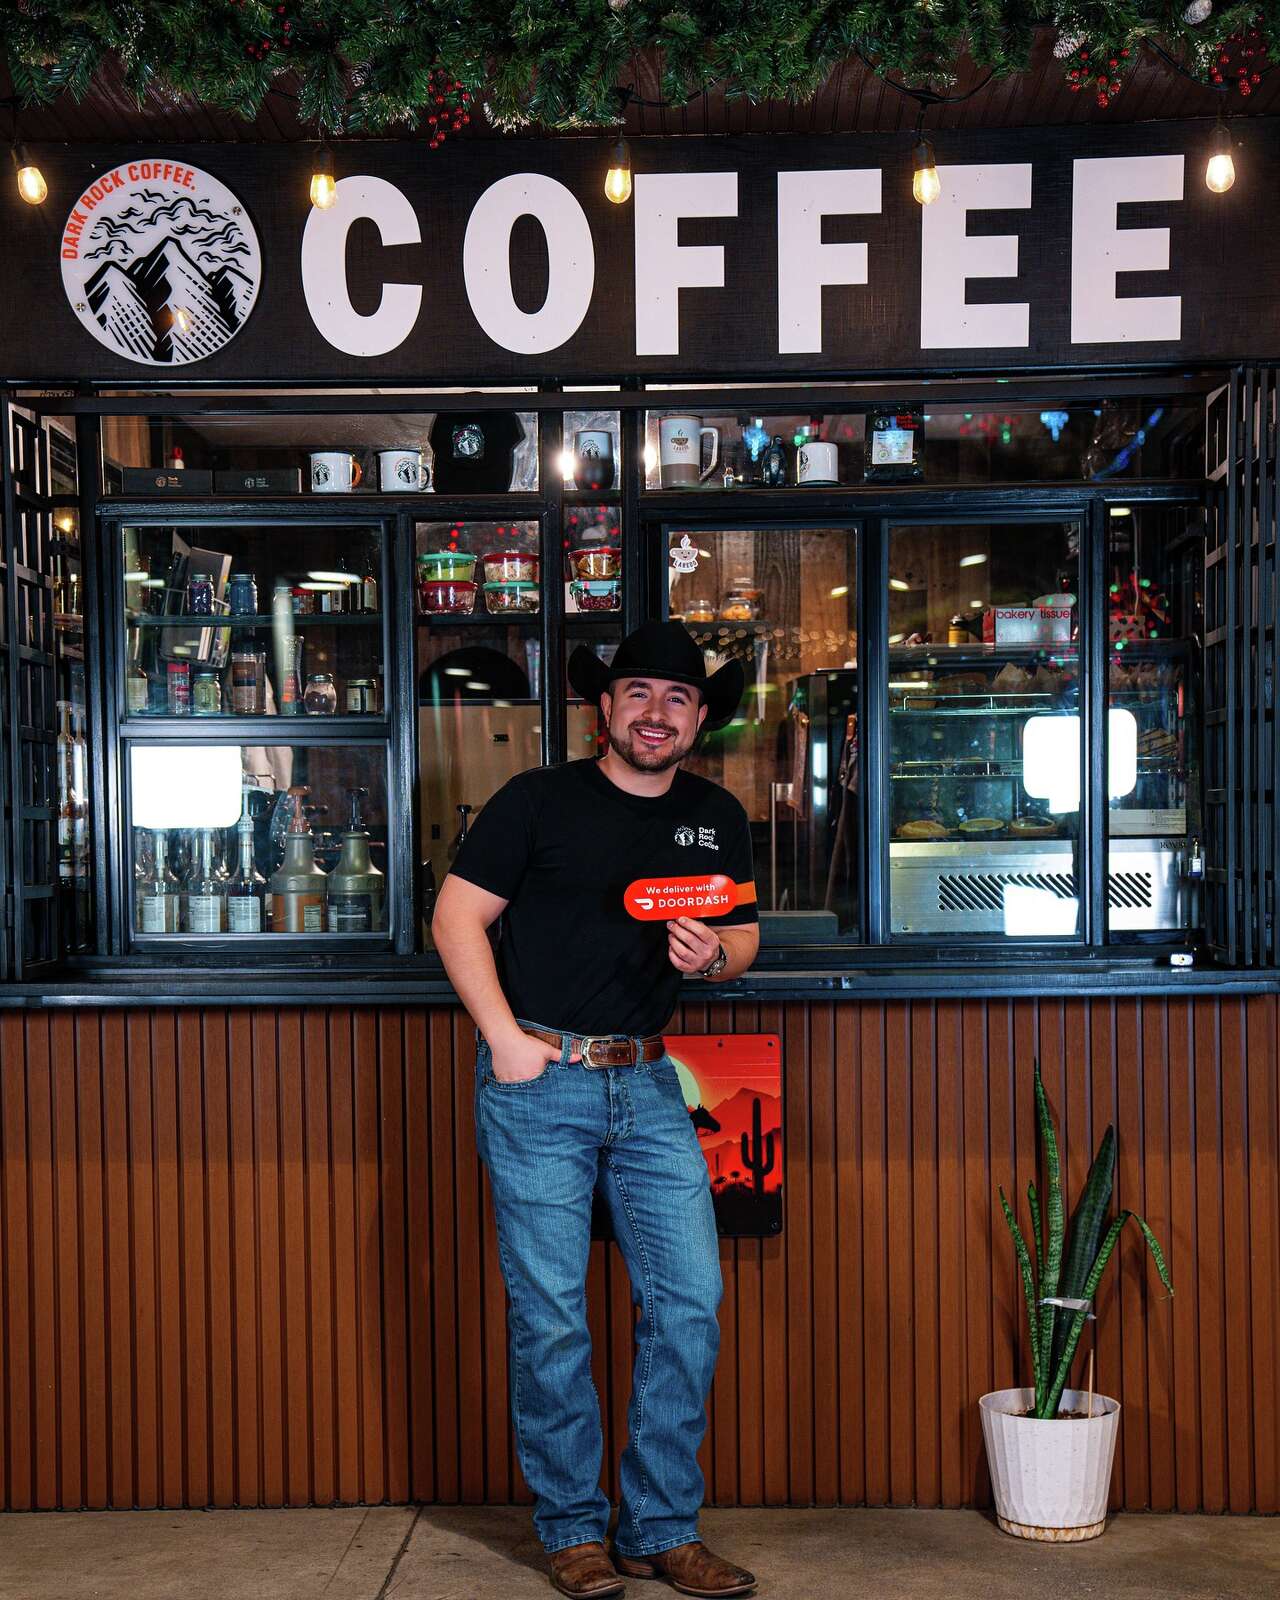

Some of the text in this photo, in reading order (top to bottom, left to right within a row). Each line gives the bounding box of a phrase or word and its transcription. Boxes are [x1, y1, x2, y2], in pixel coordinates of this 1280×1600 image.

[62, 163, 196, 260] DARK ROCK COFFEE.
[301, 154, 1185, 357] COFFEE
[996, 609, 1071, 621] bakery tissue
[698, 826, 716, 835] Dark
[646, 883, 716, 894] We deliver with
[658, 895, 729, 908] DOORDASH
